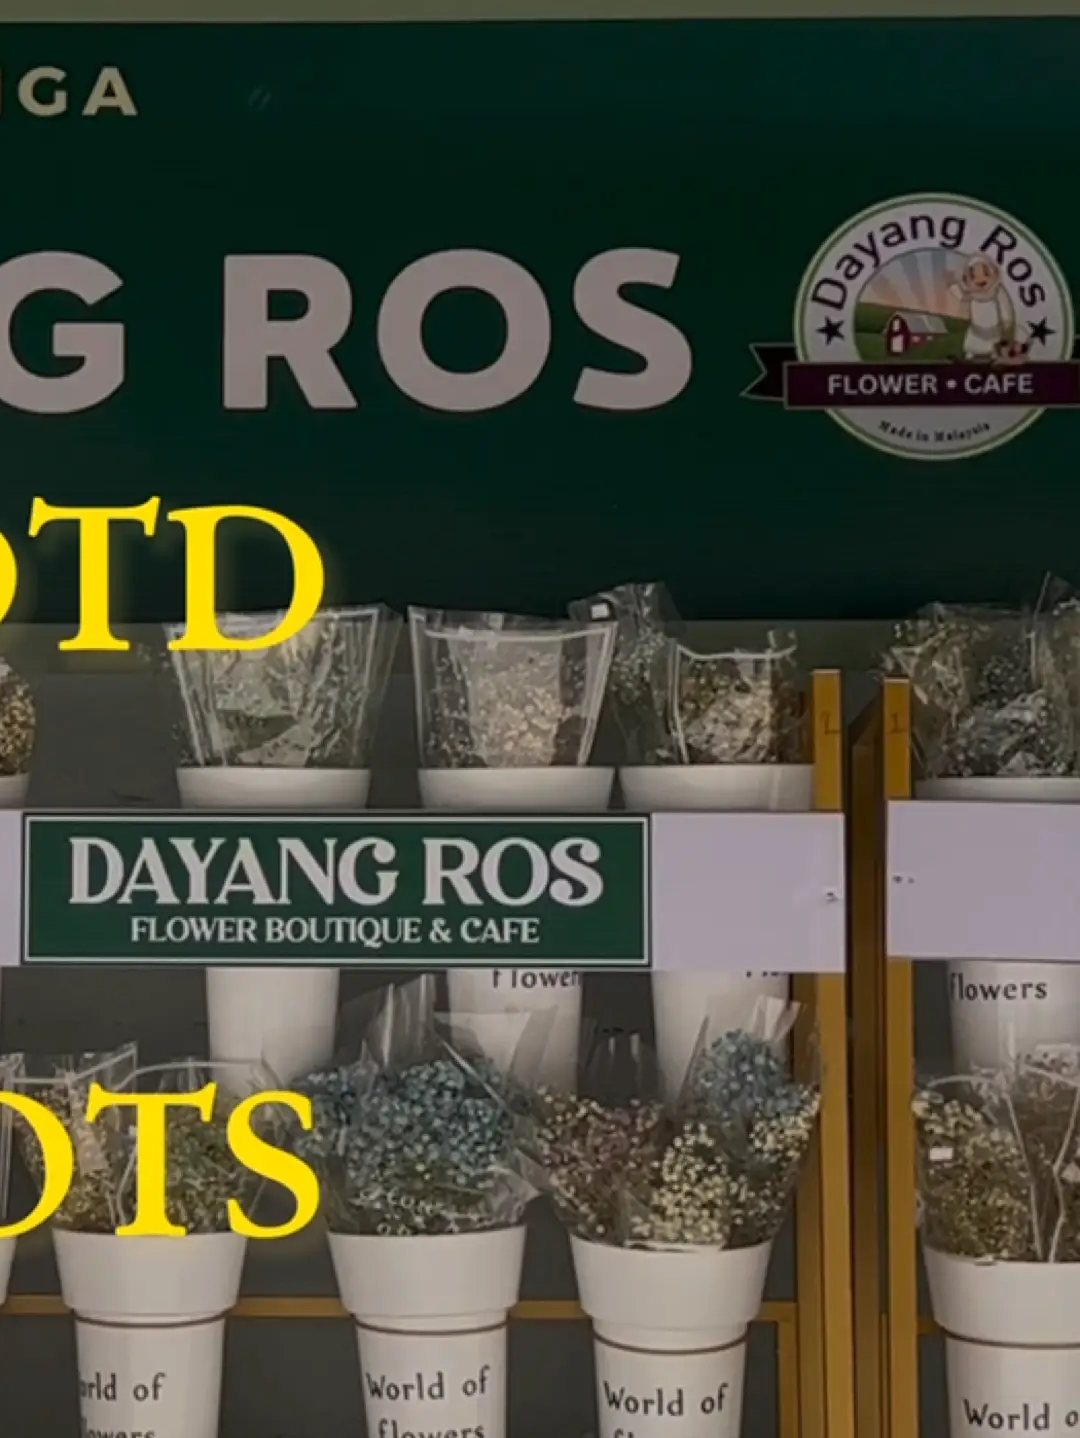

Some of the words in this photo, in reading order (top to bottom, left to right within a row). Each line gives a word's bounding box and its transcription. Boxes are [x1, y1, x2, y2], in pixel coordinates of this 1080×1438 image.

[810, 214, 967, 311] Dayang
[978, 224, 1046, 308] Ros
[223, 248, 694, 412] ROS
[828, 373, 938, 396] FLOWER
[964, 373, 1034, 395] CAFE
[68, 836, 397, 907] DAYANG
[422, 836, 602, 908] ROS
[130, 916, 257, 943] FLOWER
[265, 916, 420, 950] BOUTIQUE
[432, 917, 451, 943] &
[461, 917, 539, 944] CAFE
[133, 1372, 166, 1402] of
[366, 1371, 445, 1401] World
[462, 1365, 491, 1396] of
[603, 1381, 683, 1417] World
[701, 1382, 729, 1414] of
[963, 1398, 1050, 1431] World
